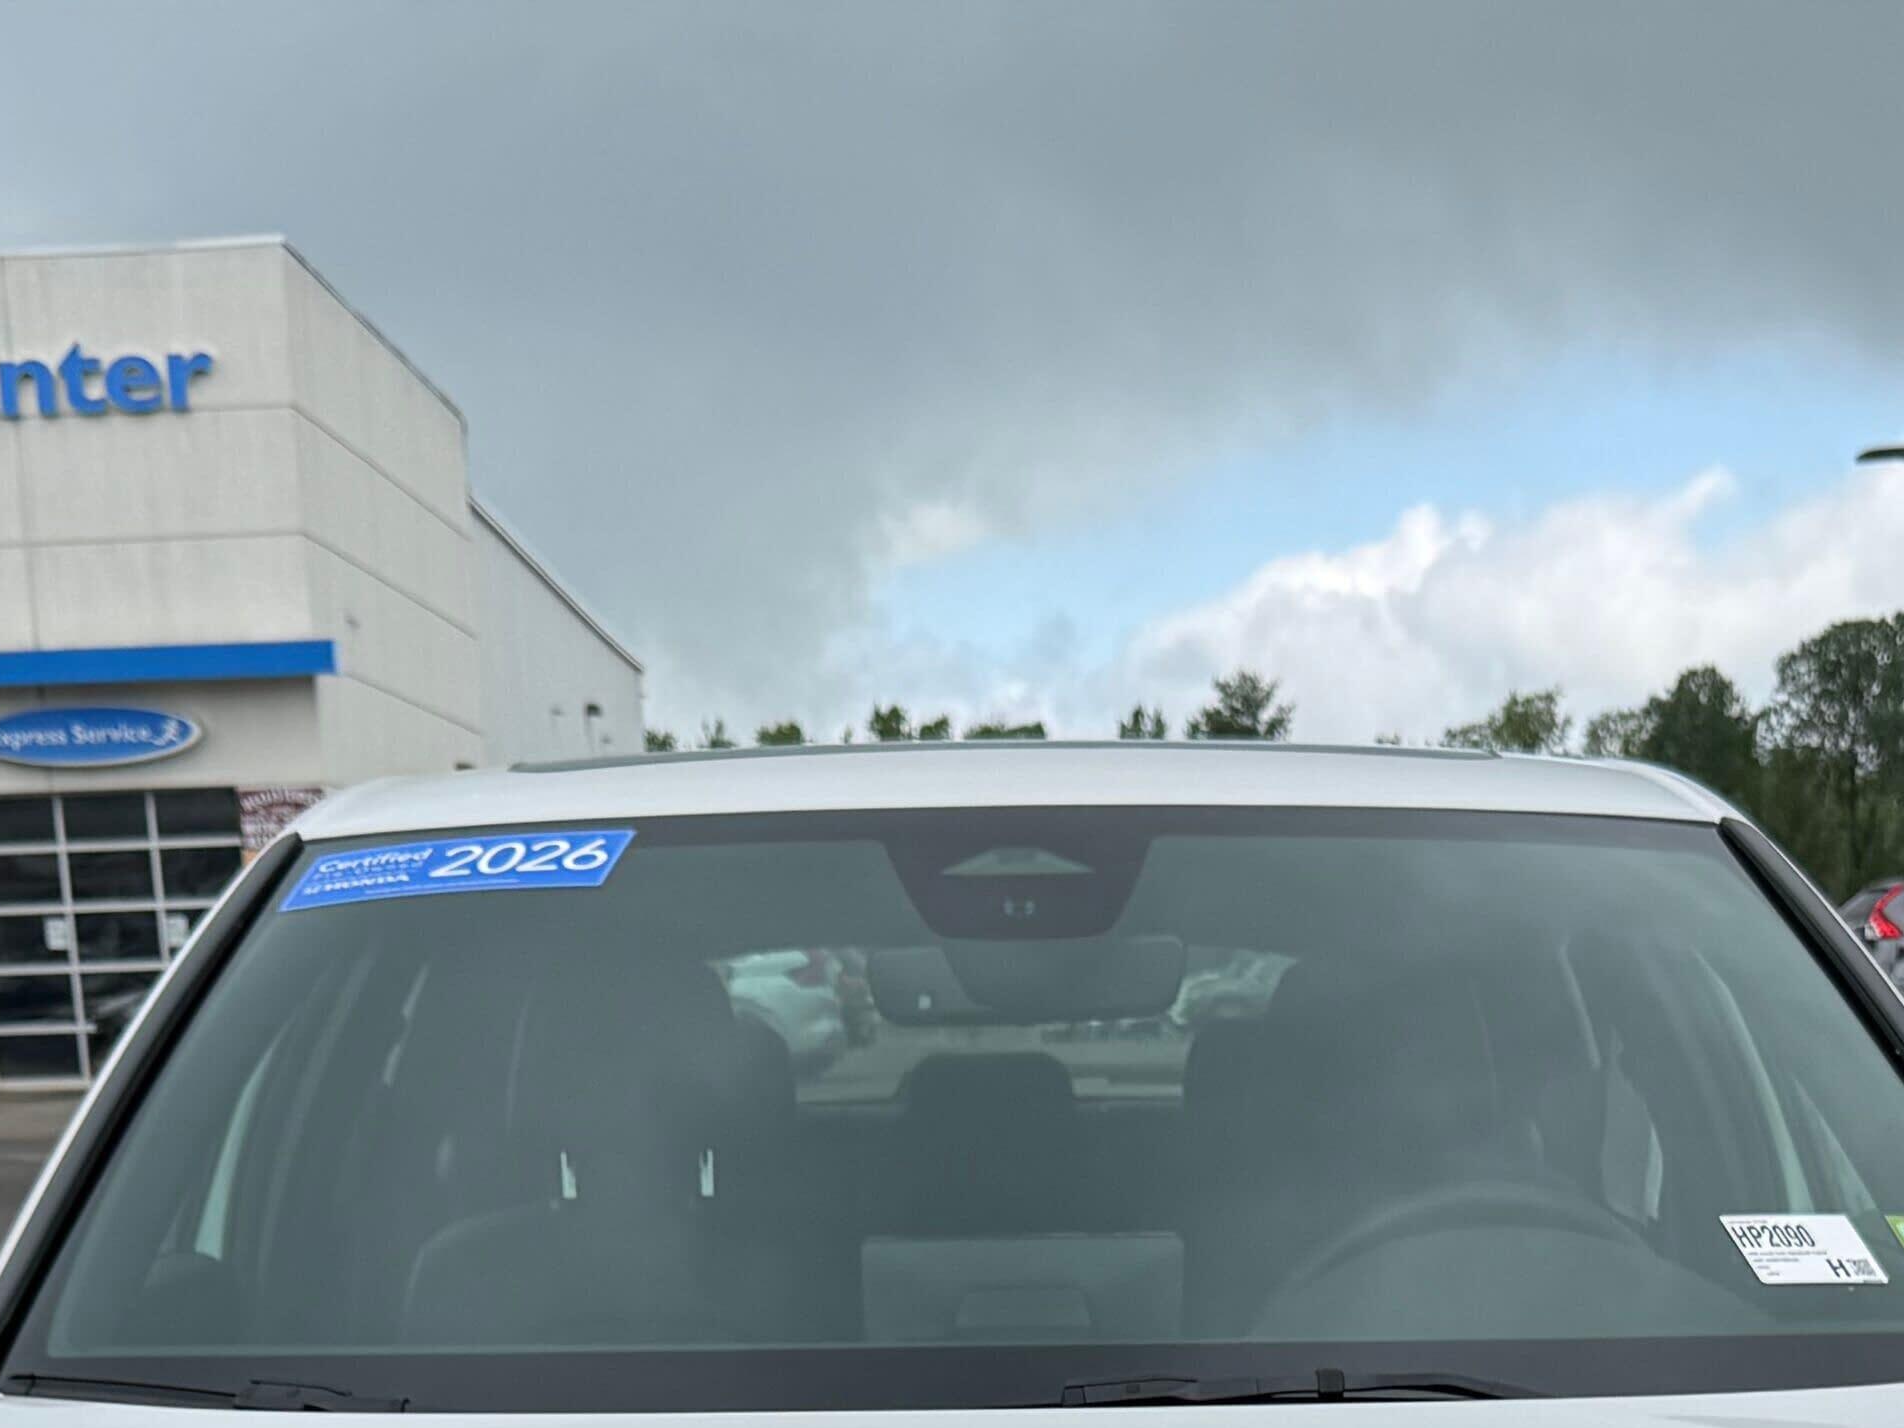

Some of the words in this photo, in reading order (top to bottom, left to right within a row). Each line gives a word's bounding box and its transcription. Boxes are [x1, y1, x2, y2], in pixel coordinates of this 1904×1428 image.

[70, 721, 152, 744] Service
[319, 848, 434, 873] Certified
[429, 836, 609, 877] 2026
[1731, 1224, 1816, 1249] HP2090
